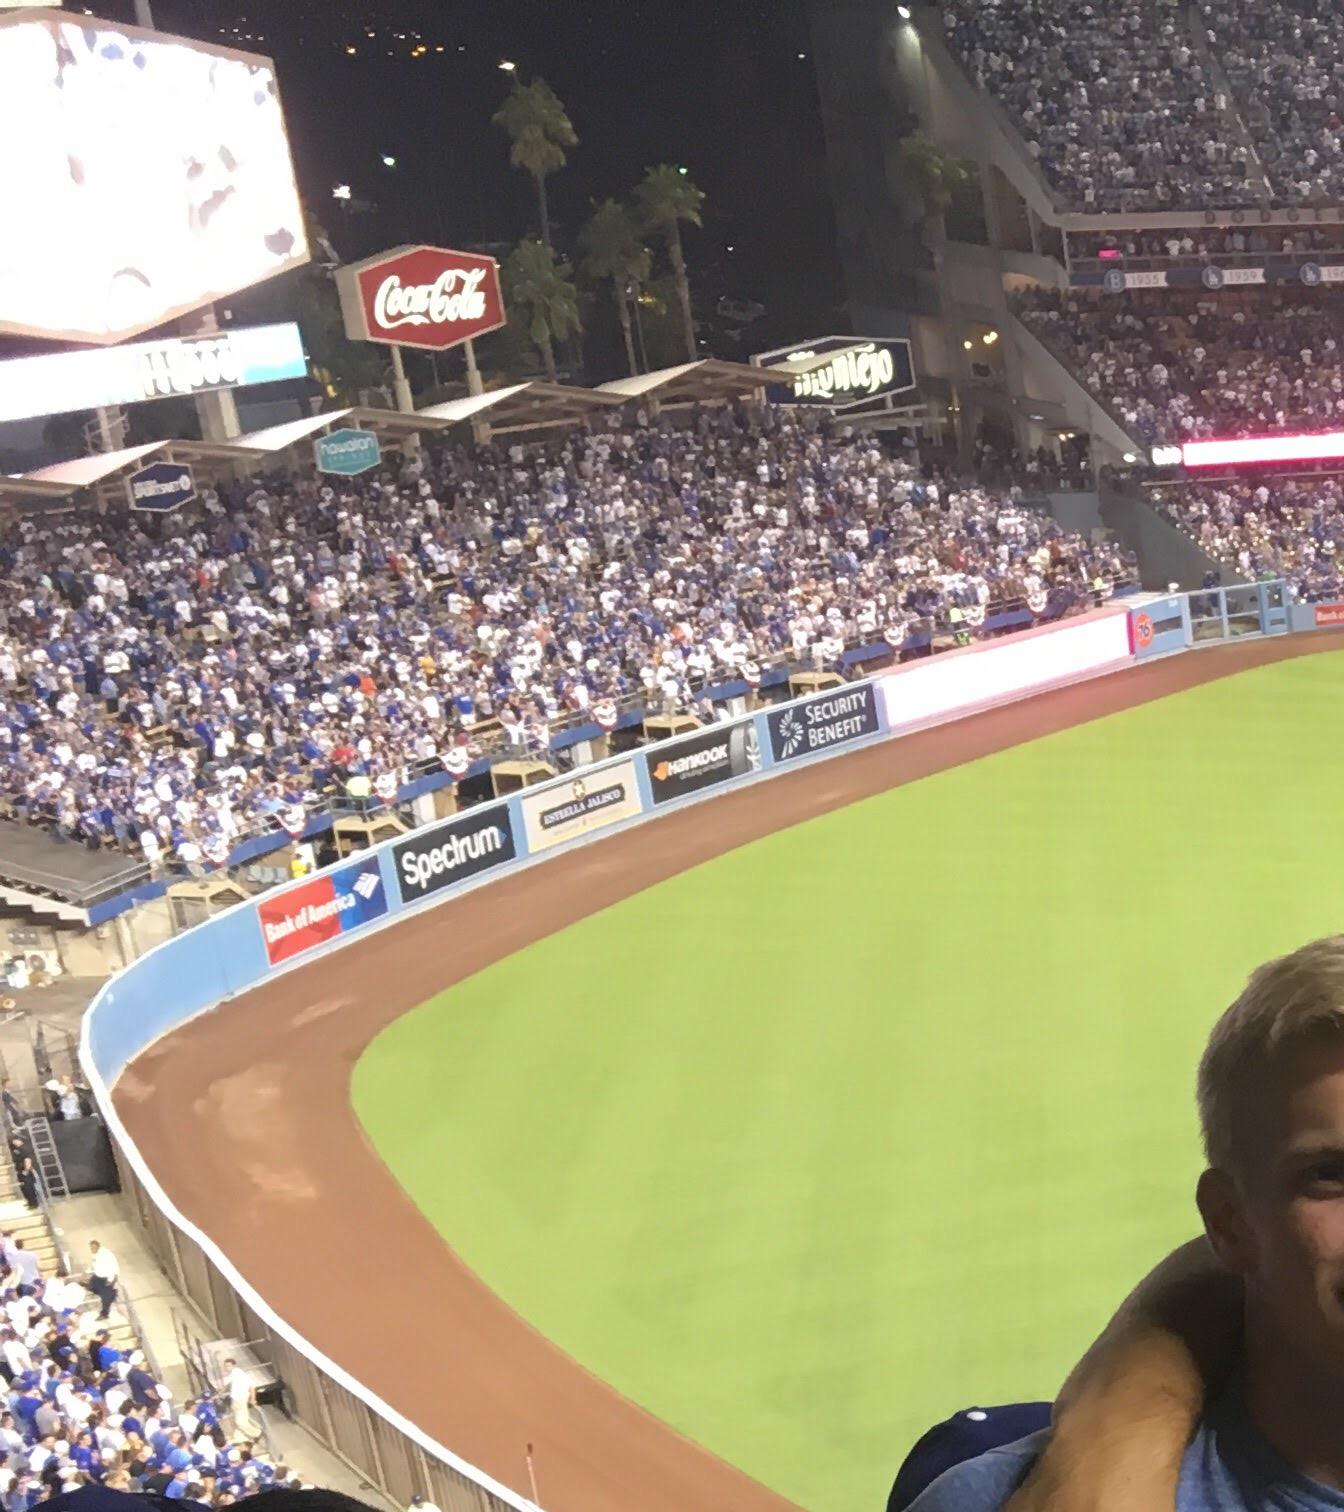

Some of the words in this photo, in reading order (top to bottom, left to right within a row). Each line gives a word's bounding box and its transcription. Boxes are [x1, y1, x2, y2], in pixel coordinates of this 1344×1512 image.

[374, 267, 487, 329] Coca-Cola
[1316, 609, 1337, 621] Bank
[805, 691, 867, 725] SECURITY
[401, 826, 502, 889] Spectrum
[264, 914, 296, 943] Bank
[307, 892, 356, 925] America
